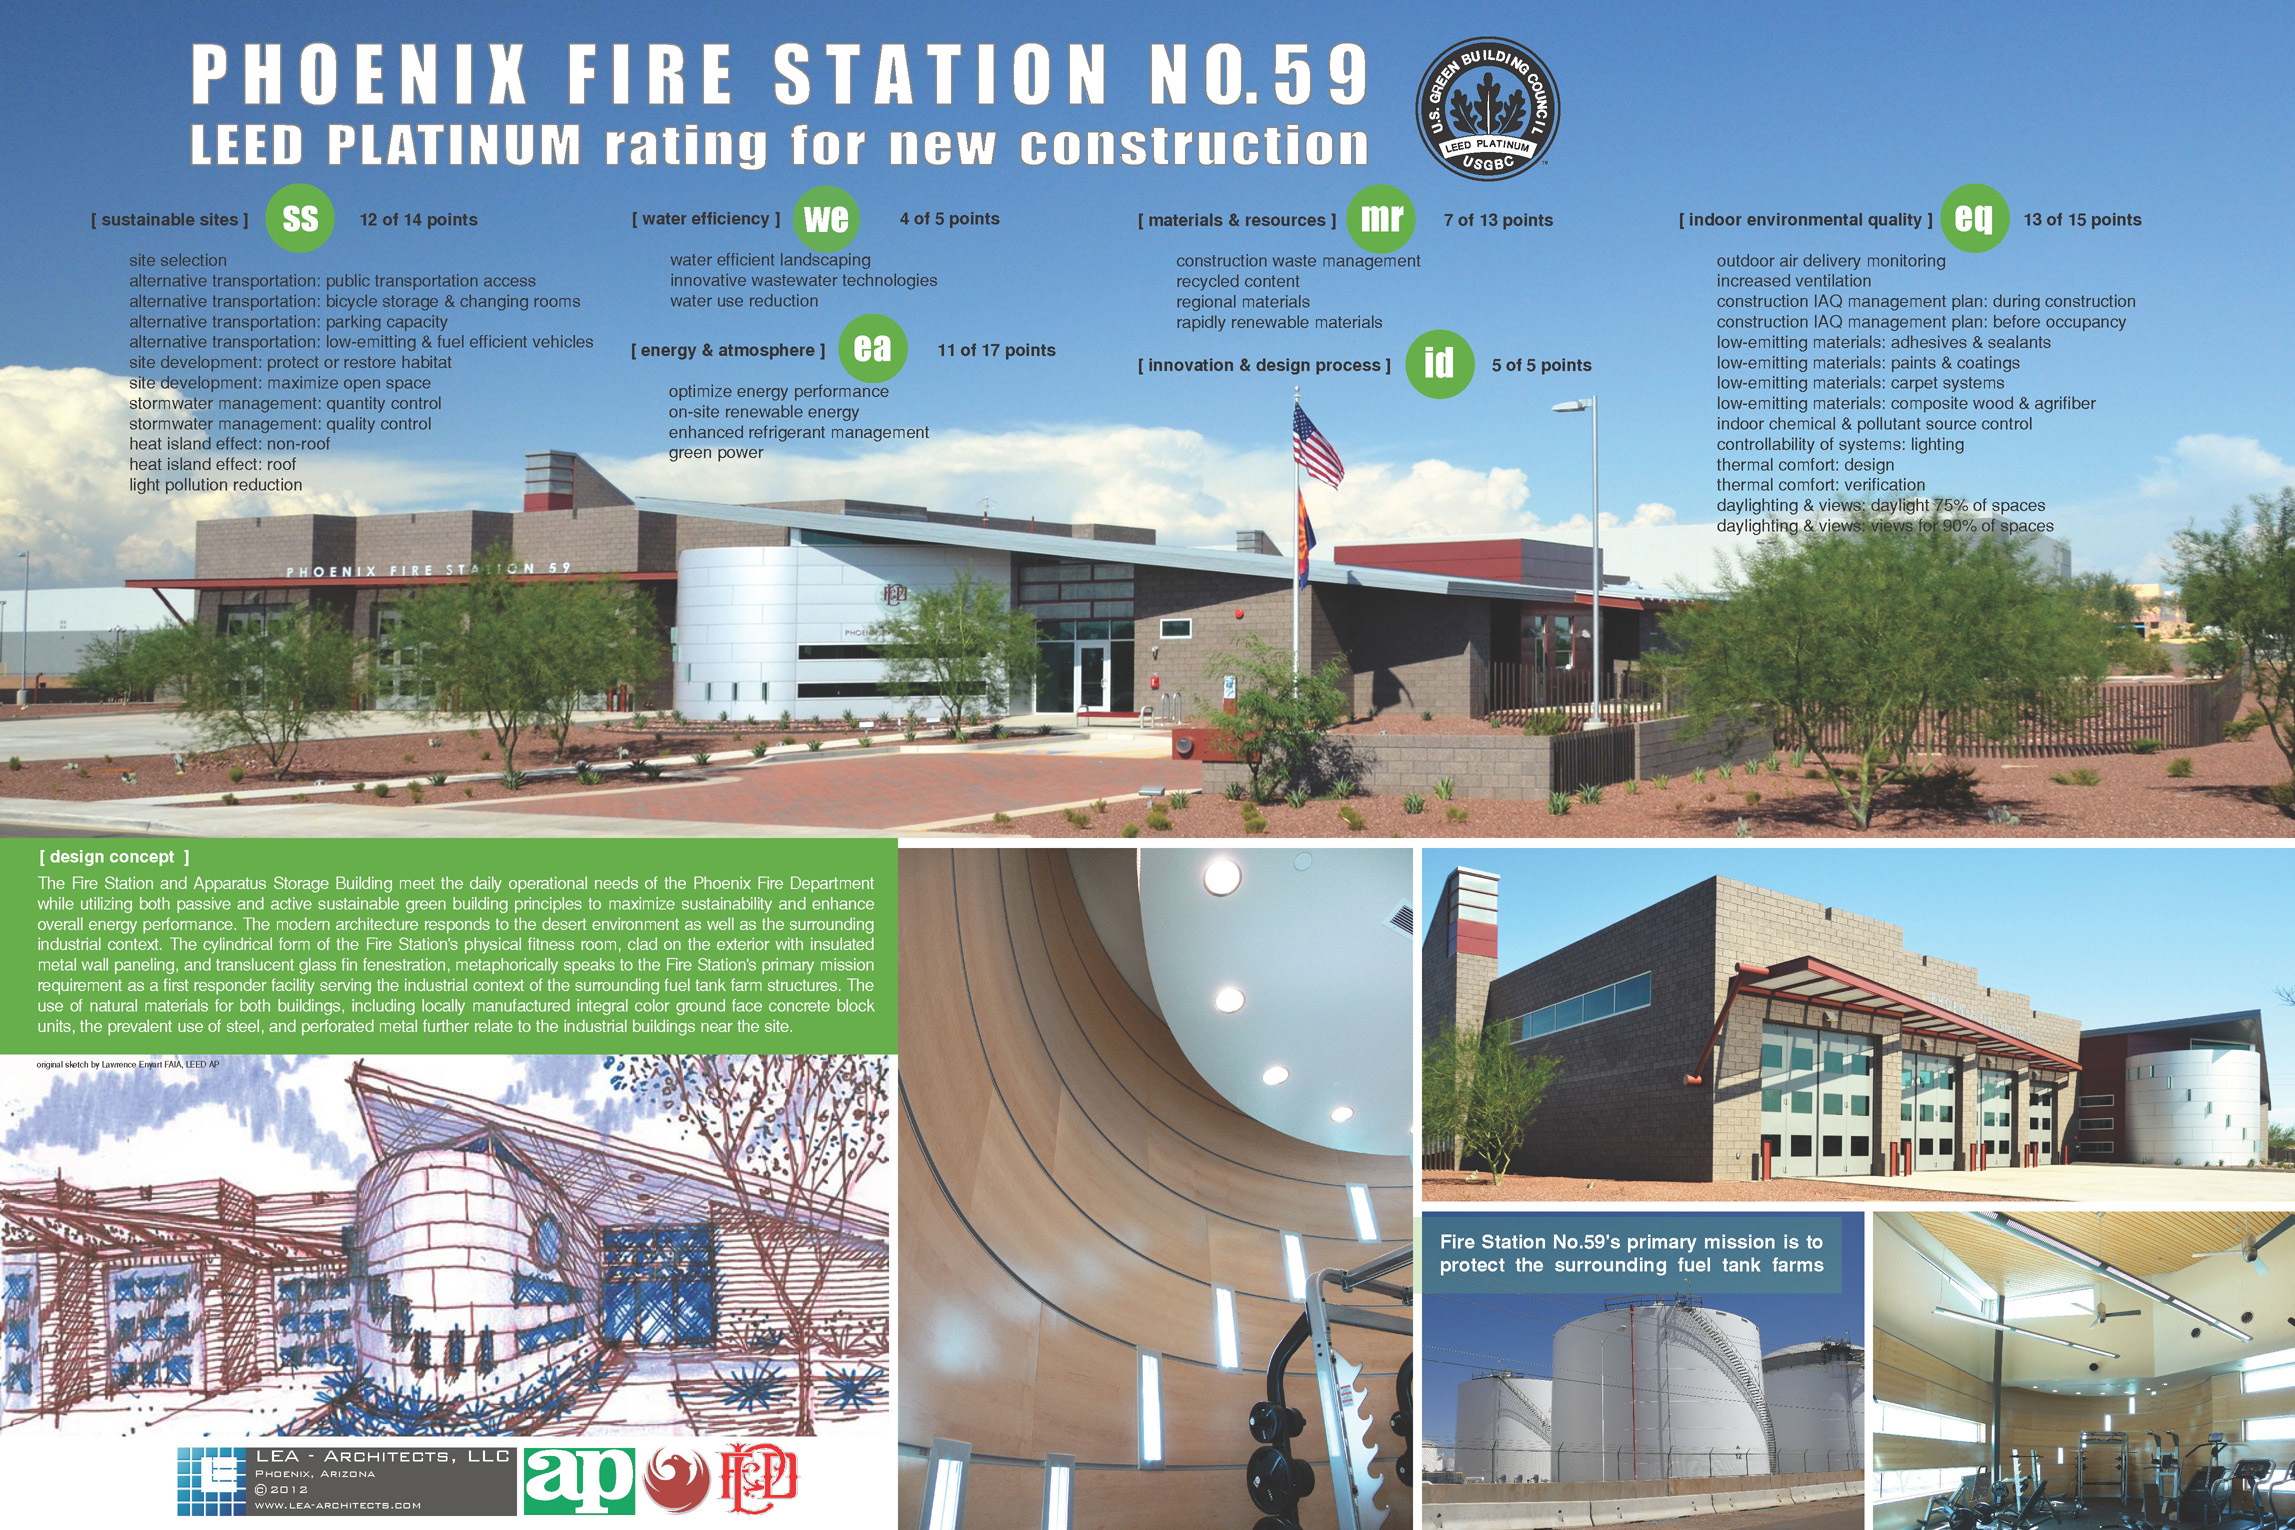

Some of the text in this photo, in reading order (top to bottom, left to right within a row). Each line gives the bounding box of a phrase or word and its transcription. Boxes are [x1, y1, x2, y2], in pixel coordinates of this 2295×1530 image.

[287, 565, 376, 578] PHOENIX
[390, 564, 433, 577] FIRE
[548, 562, 571, 574] 59
